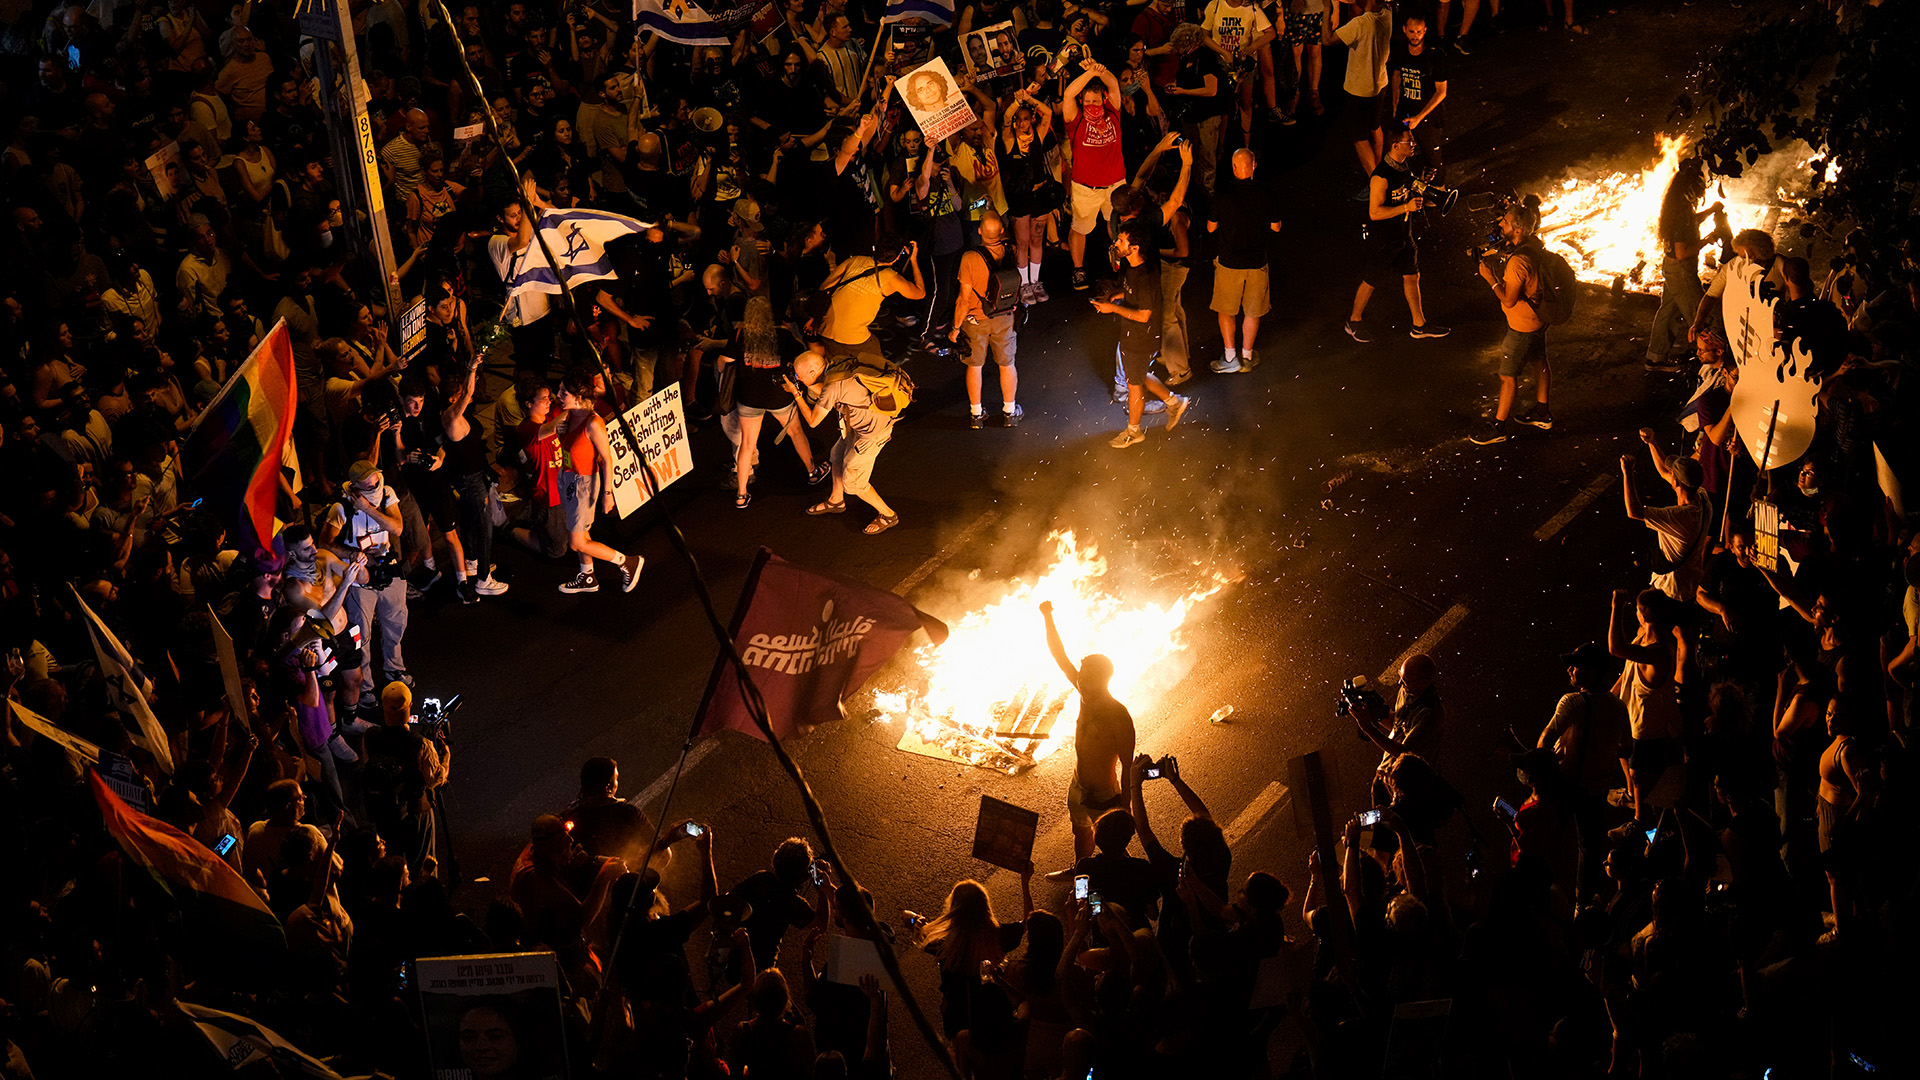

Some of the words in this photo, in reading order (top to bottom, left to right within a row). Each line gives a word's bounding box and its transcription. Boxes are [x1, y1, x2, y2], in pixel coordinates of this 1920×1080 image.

[1222, 17, 1241, 26] אתה
[1218, 27, 1245, 36] הראש
[1220, 36, 1240, 45] אתה
[949, 99, 964, 109] HANDS
[946, 114, 974, 132] WARRANT!
[360, 117, 375, 164] 878
[402, 324, 412, 342] NO
[412, 312, 426, 335] ONE
[606, 412, 641, 446] Enogh
[643, 397, 662, 418] with
[663, 389, 679, 404] the
[613, 453, 639, 489] Seal
[642, 441, 662, 462] the
[662, 423, 683, 450] Deal
[437, 1068, 473, 1080] BRING
